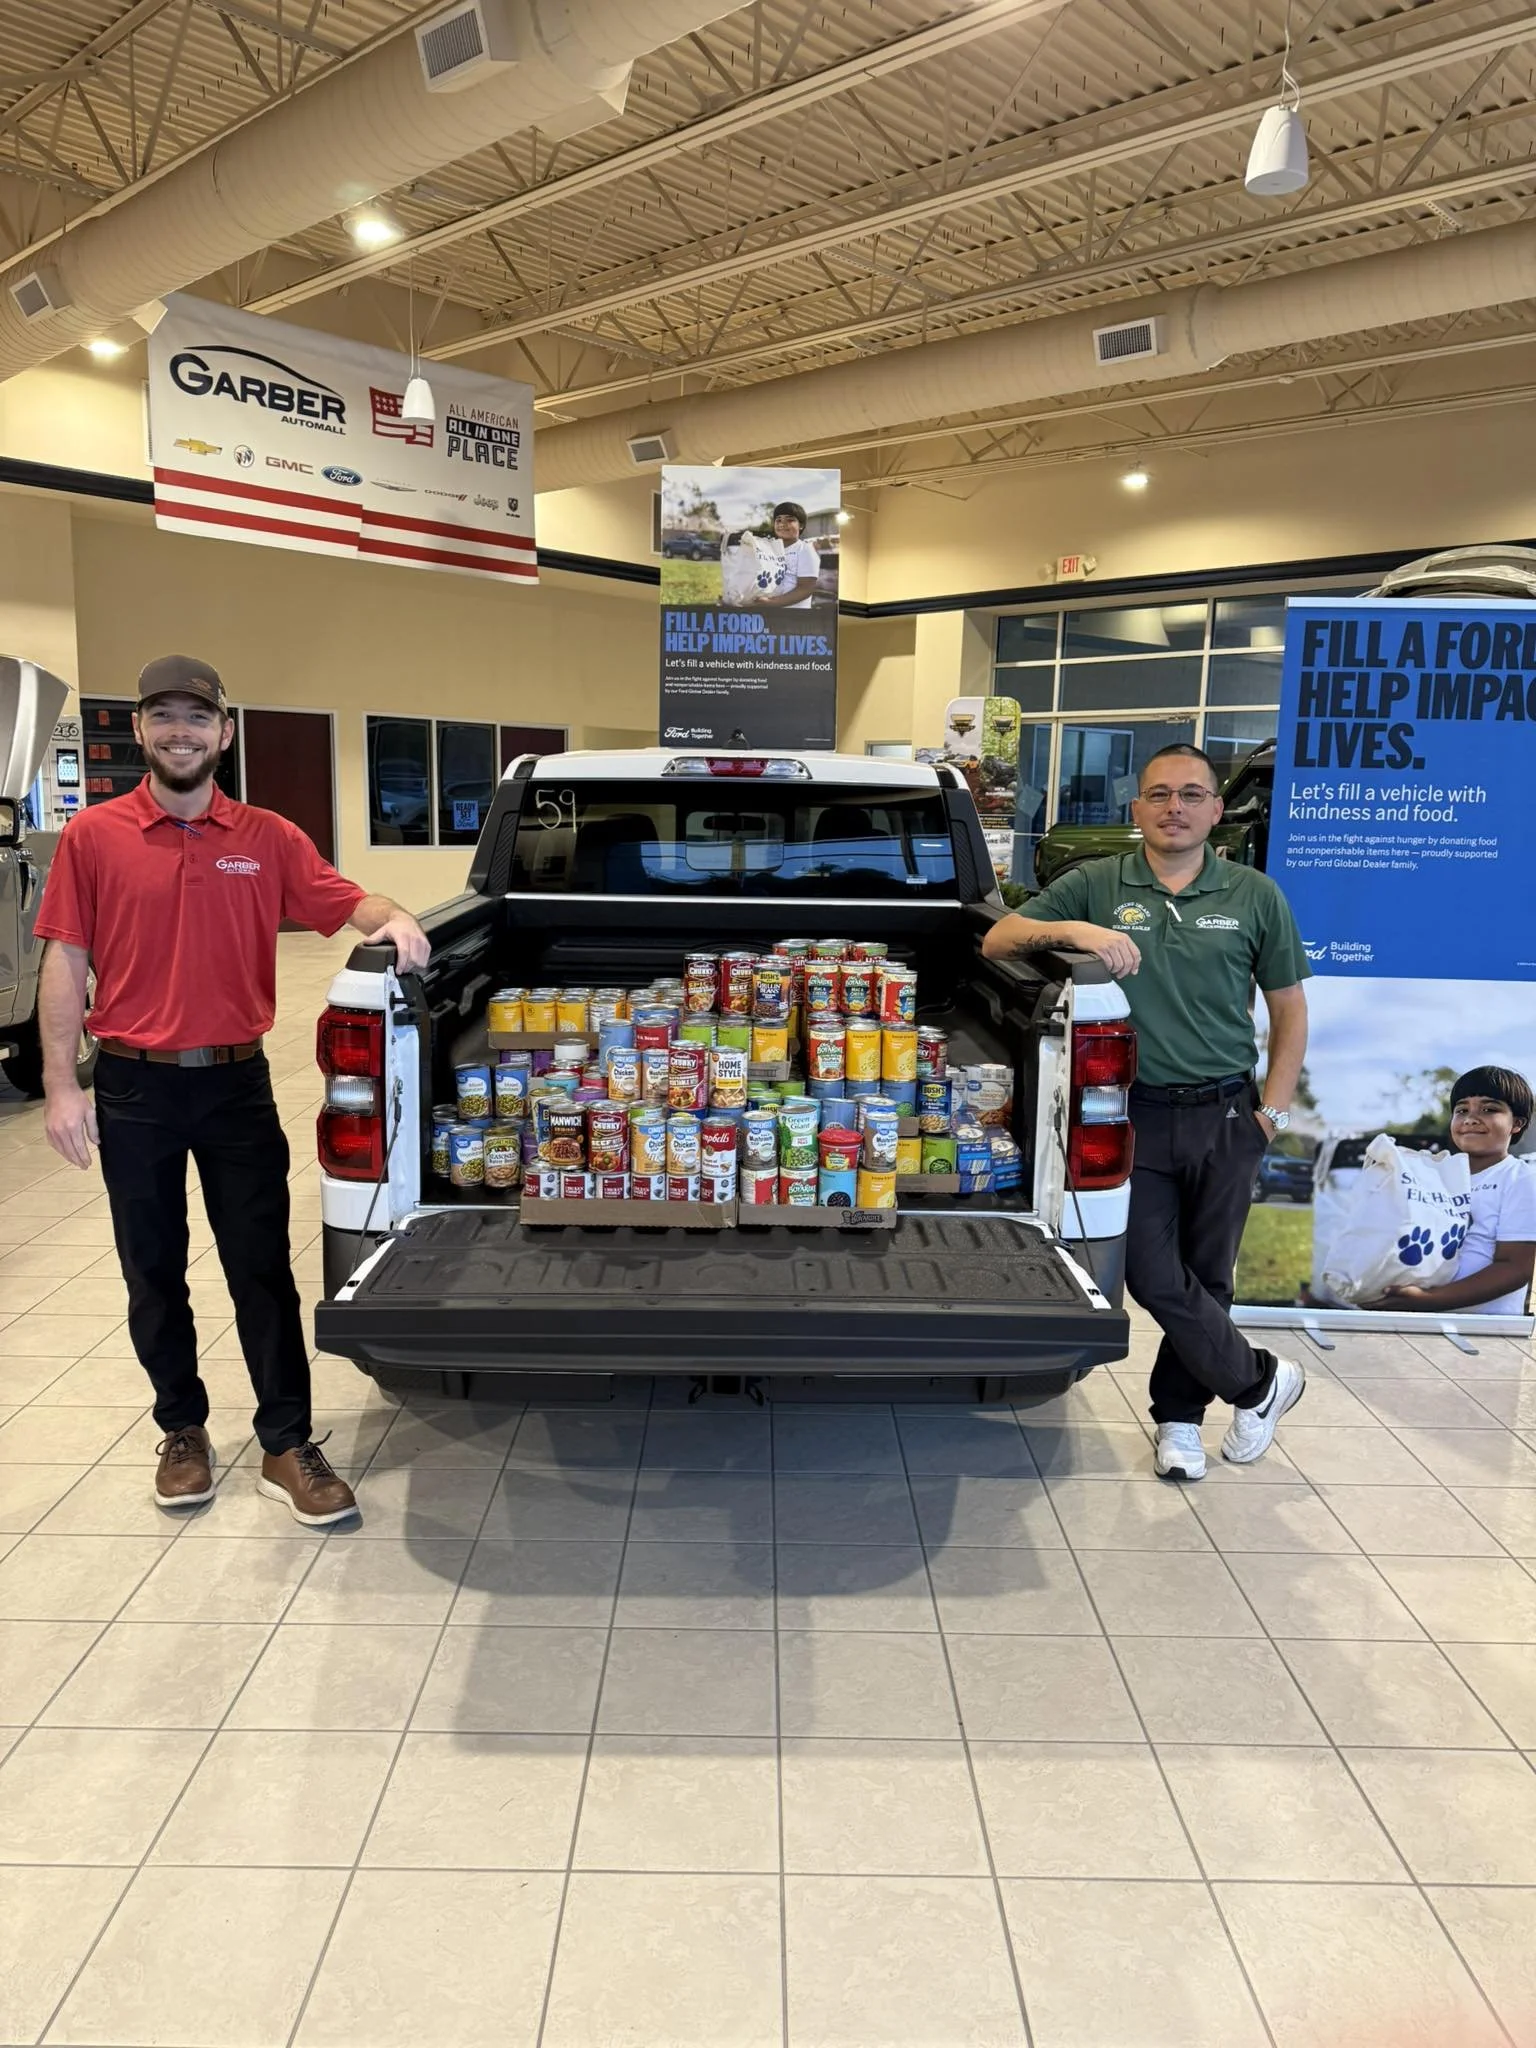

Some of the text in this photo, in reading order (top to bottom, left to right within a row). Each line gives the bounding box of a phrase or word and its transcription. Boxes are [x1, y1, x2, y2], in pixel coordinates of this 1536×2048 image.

[169, 352, 346, 424] GARBER
[449, 403, 519, 429] ALL AMERICAN
[280, 414, 346, 436] AUTOMALL
[448, 418, 519, 446] ALL IN ONE
[447, 435, 519, 470] PLACE
[265, 456, 314, 475] GMC
[329, 468, 354, 485] Ford
[1062, 556, 1080, 574] EXIT
[665, 611, 770, 634] FILL A FORD.
[665, 632, 833, 656] HELP IMPACT LIVES.
[1302, 620, 1388, 668] FILL
[1396, 621, 1426, 669] A
[665, 658, 833, 671] Let's fill a vehicle with kindness and food.
[1298, 671, 1410, 719] HELP
[664, 727, 690, 739] Ford
[1294, 722, 1426, 769] LIVES.
[1291, 782, 1487, 803] Let's fill a vehicle with
[535, 789, 577, 834] 59
[1289, 802, 1459, 823] kindness and food.
[1287, 834, 1498, 847] Join us in the fight against hunger by donating food
[1287, 846, 1304, 855] and
[1304, 846, 1366, 857] nonperishable
[1366, 847, 1390, 856] items
[1391, 847, 1410, 857] here
[1421, 848, 1454, 859] proudly
[1454, 848, 1499, 860] supported
[216, 860, 261, 871] GARBER
[1286, 858, 1419, 870] by our Ford Global Dealer family.
[1196, 917, 1240, 927] GARBER
[1330, 941, 1371, 953] Building
[1330, 951, 1374, 963] Together
[670, 1058, 696, 1067] CHUNKY
[718, 1060, 742, 1069] HOME
[718, 1069, 742, 1078] STYLE
[923, 1086, 946, 1094] BUSH'S
[550, 1115, 582, 1127] MANWICH
[592, 1121, 620, 1130] CHUNKY
[790, 1122, 811, 1130] Giant
[673, 1140, 696, 1149] Chicken
